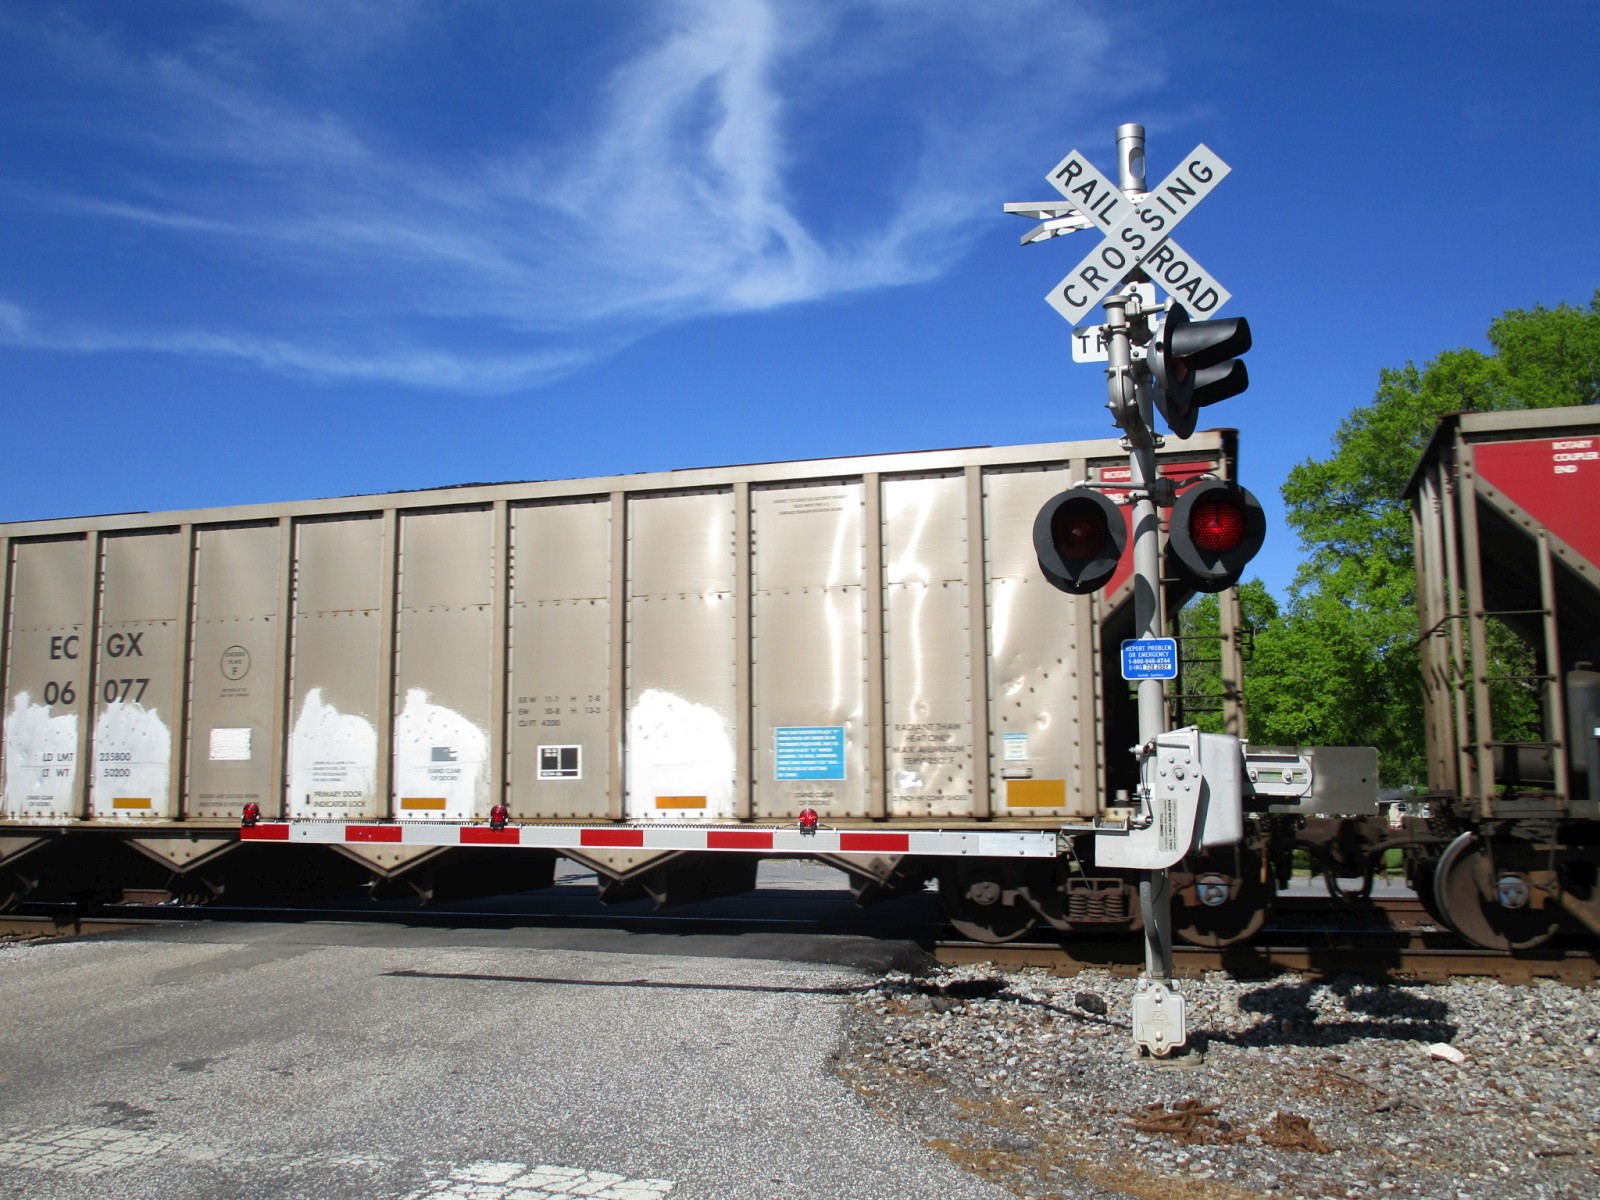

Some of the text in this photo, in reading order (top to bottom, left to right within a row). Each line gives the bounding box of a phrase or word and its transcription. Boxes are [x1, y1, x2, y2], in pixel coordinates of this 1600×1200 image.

[1056, 159, 1219, 313] RAIL ROAD
[1063, 160, 1213, 308] CROSSING
[50, 632, 144, 660] EC GX
[44, 678, 150, 707] 06 077
[43, 753, 131, 762] LD LMT 235800
[56, 769, 70, 777] WT
[104, 769, 130, 777] 50200
